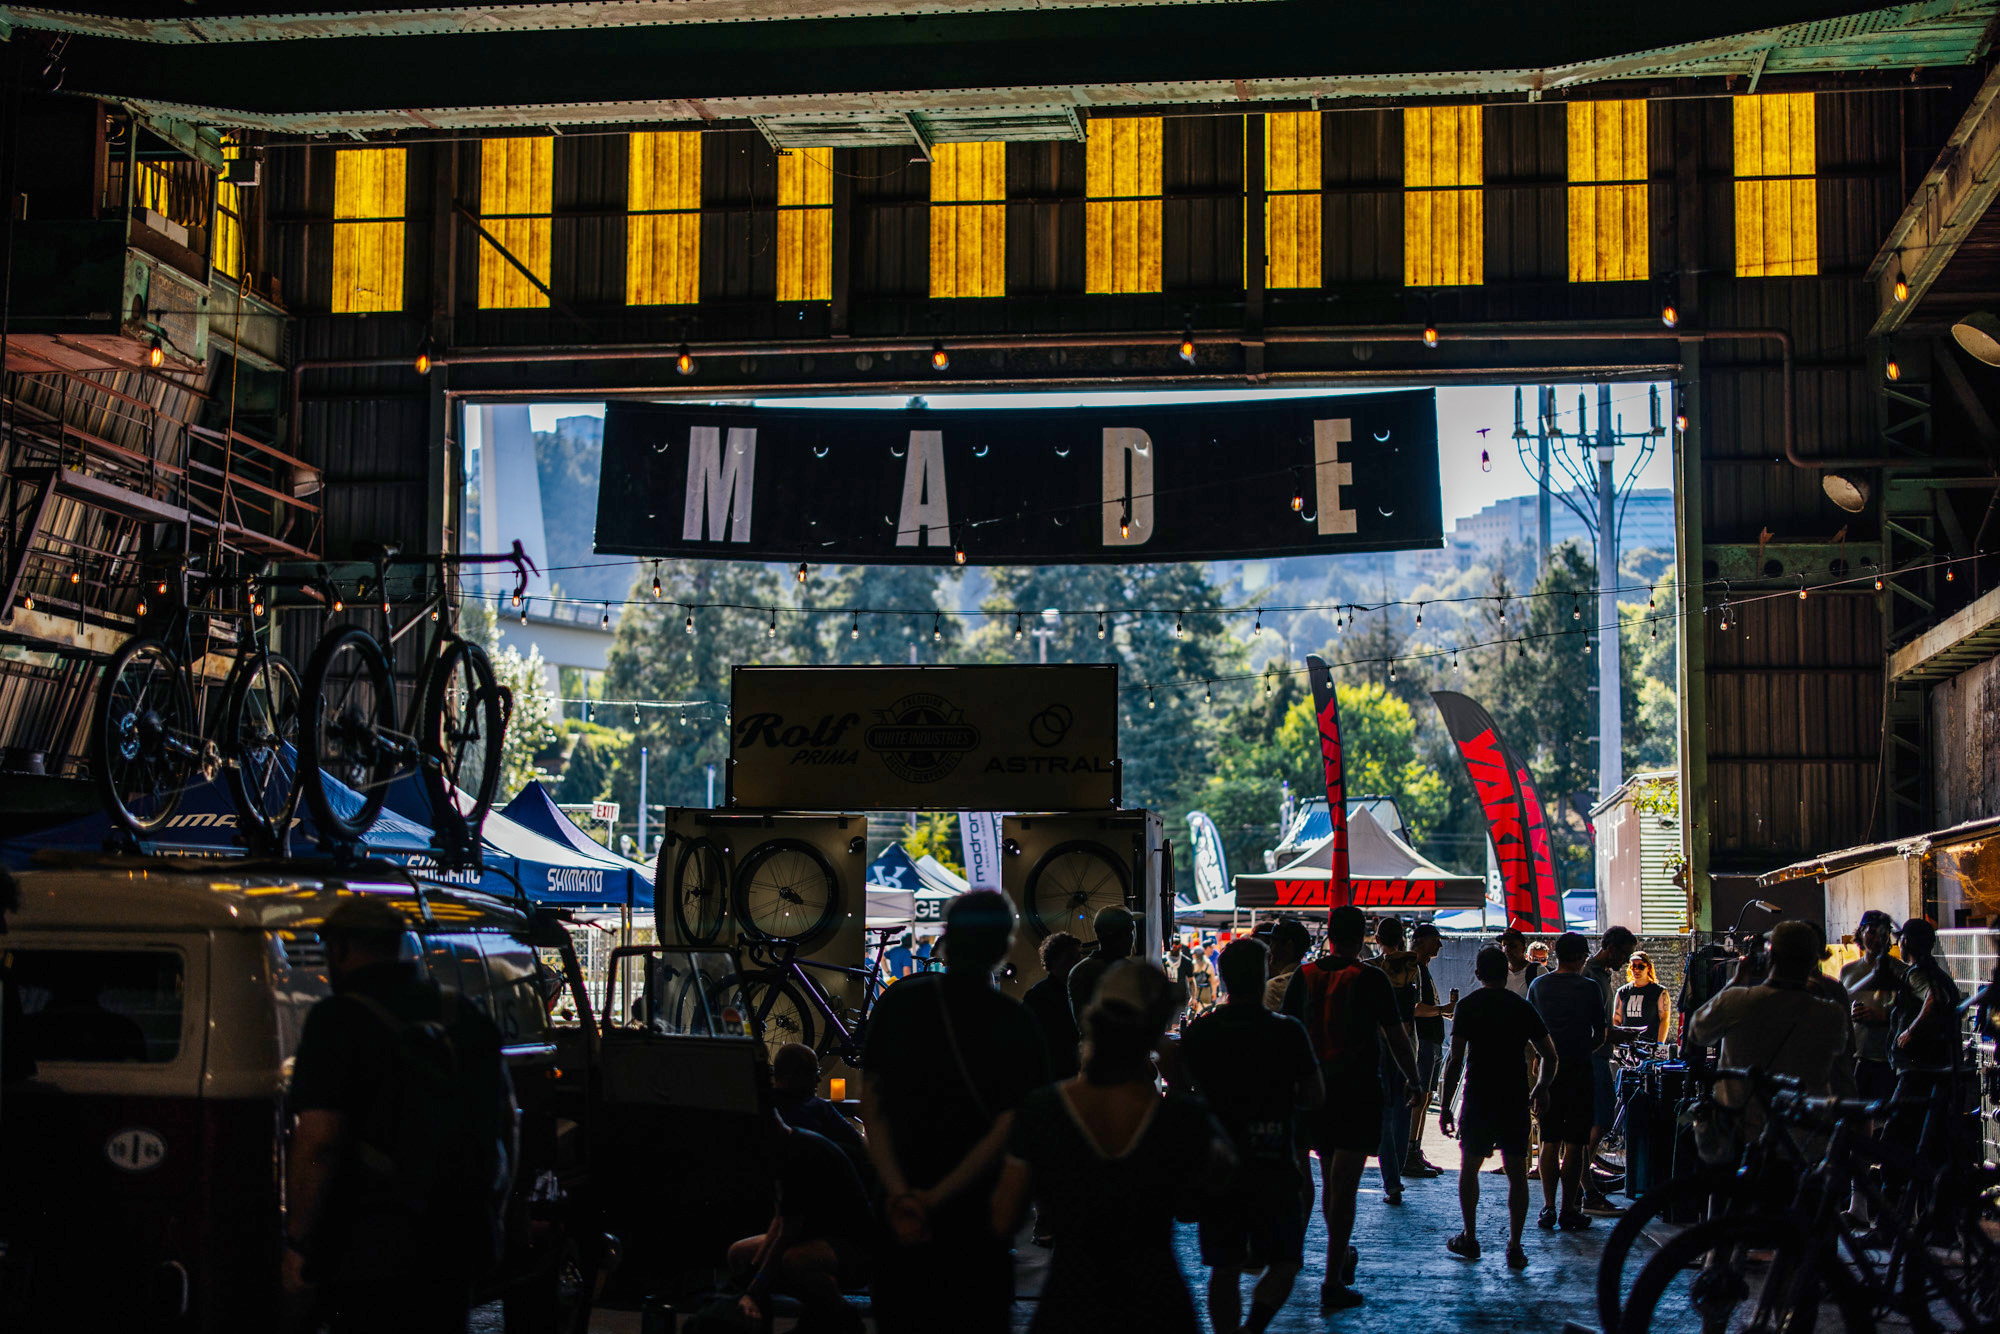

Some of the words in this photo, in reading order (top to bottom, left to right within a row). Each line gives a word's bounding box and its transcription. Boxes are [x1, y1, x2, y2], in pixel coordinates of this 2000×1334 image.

[683, 418, 1357, 545] MADE
[737, 712, 860, 748] Rolf
[874, 730, 909, 745] WHITE
[909, 730, 970, 745] INDUSTRIES
[790, 750, 859, 765] PRIMA
[984, 757, 1112, 773] ASTRAL
[597, 805, 614, 819] EXIT
[1317, 697, 1349, 910] YAKIM
[547, 868, 603, 892] SHIMANO
